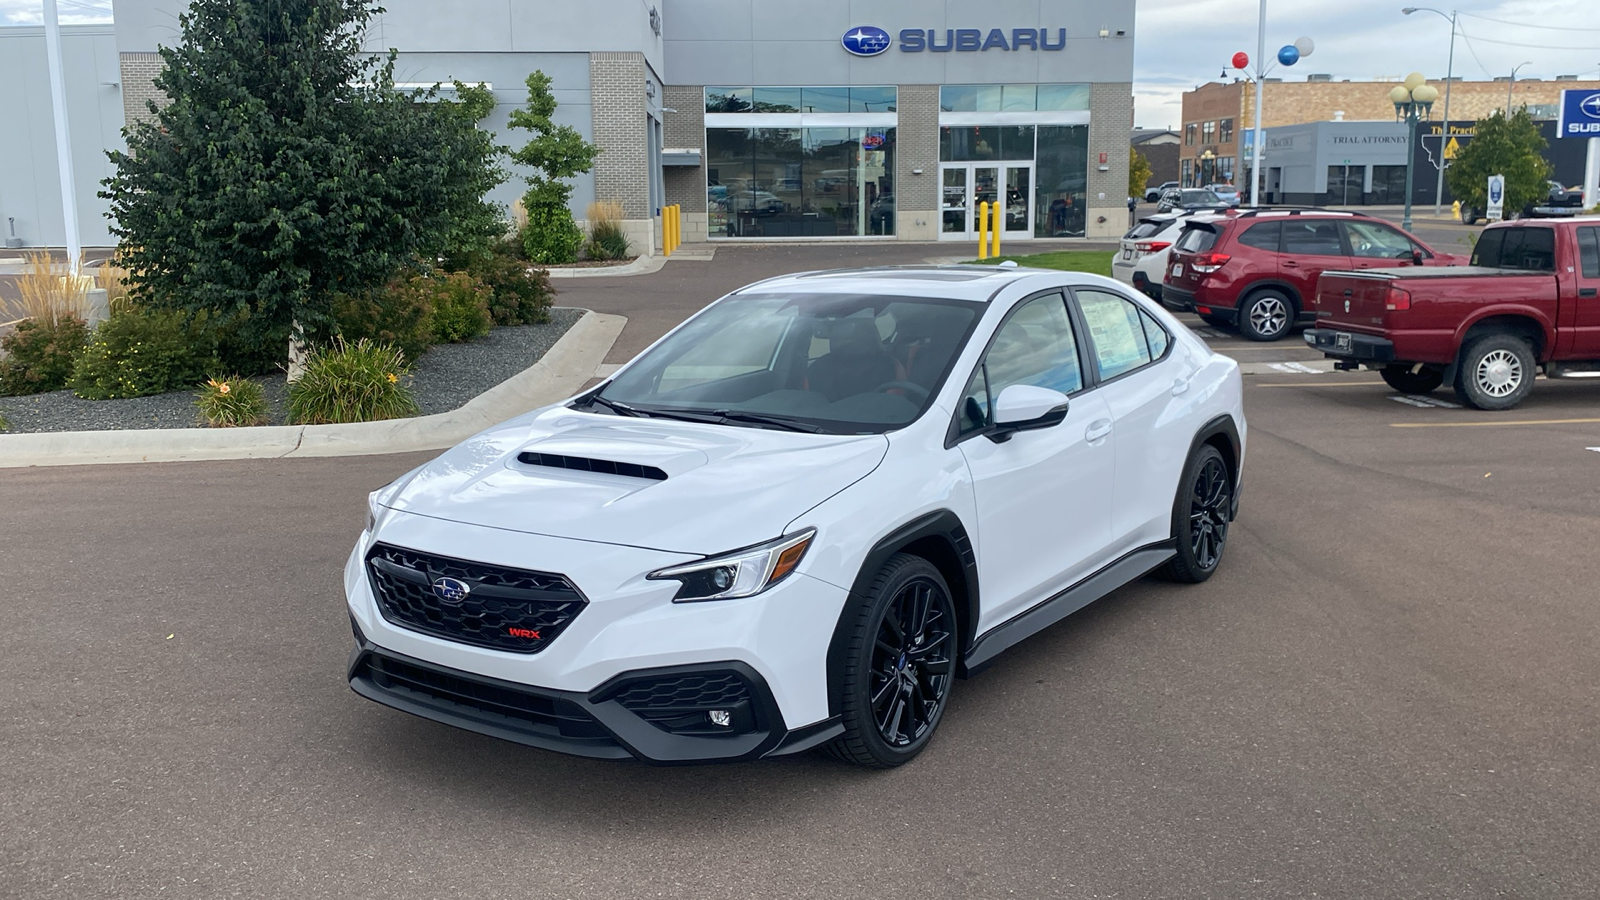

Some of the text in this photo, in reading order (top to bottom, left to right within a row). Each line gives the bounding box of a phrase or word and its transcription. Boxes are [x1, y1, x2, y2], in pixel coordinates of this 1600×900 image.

[899, 28, 1066, 52] SUBARU
[1568, 123, 1600, 133] SUB
[1332, 136, 1409, 144] TRIAL ATTORNEY
[509, 627, 541, 640] WRX
